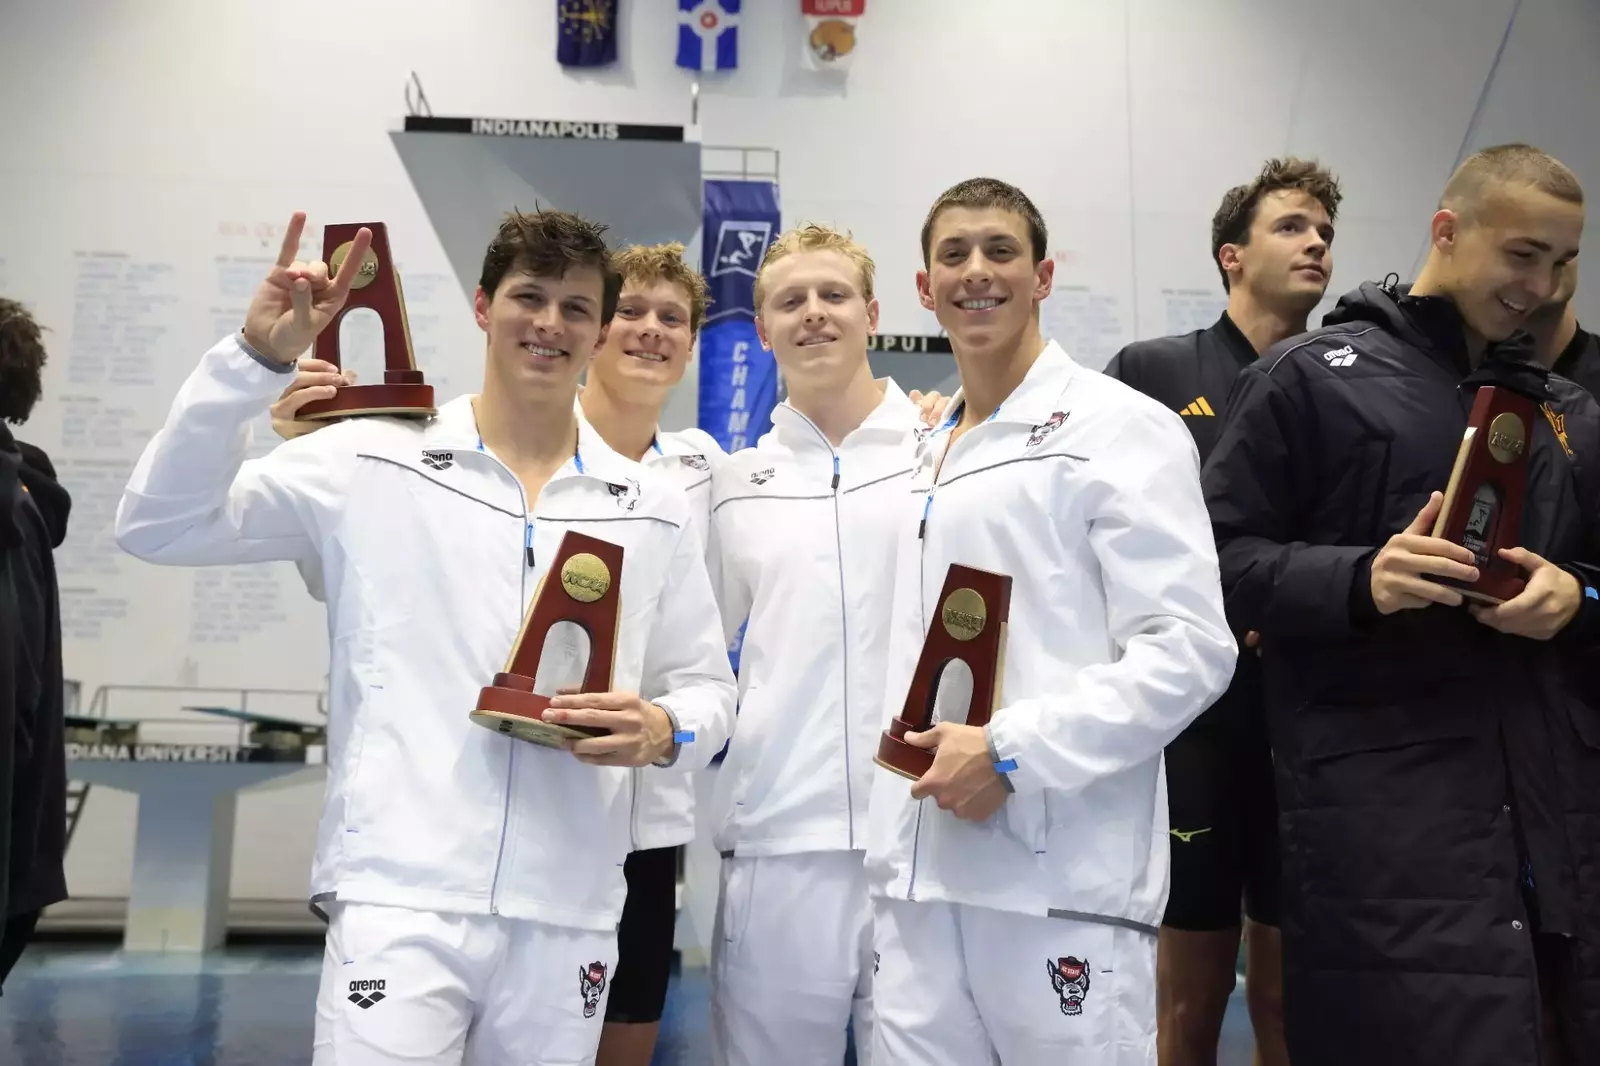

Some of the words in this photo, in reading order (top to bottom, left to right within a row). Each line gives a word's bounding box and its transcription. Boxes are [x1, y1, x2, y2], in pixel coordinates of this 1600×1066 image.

[471, 118, 620, 140] INDIANAPOLIS
[1323, 344, 1354, 362] arena
[421, 449, 453, 462] arena
[563, 568, 608, 596] NCAA
[348, 979, 386, 992] arena
